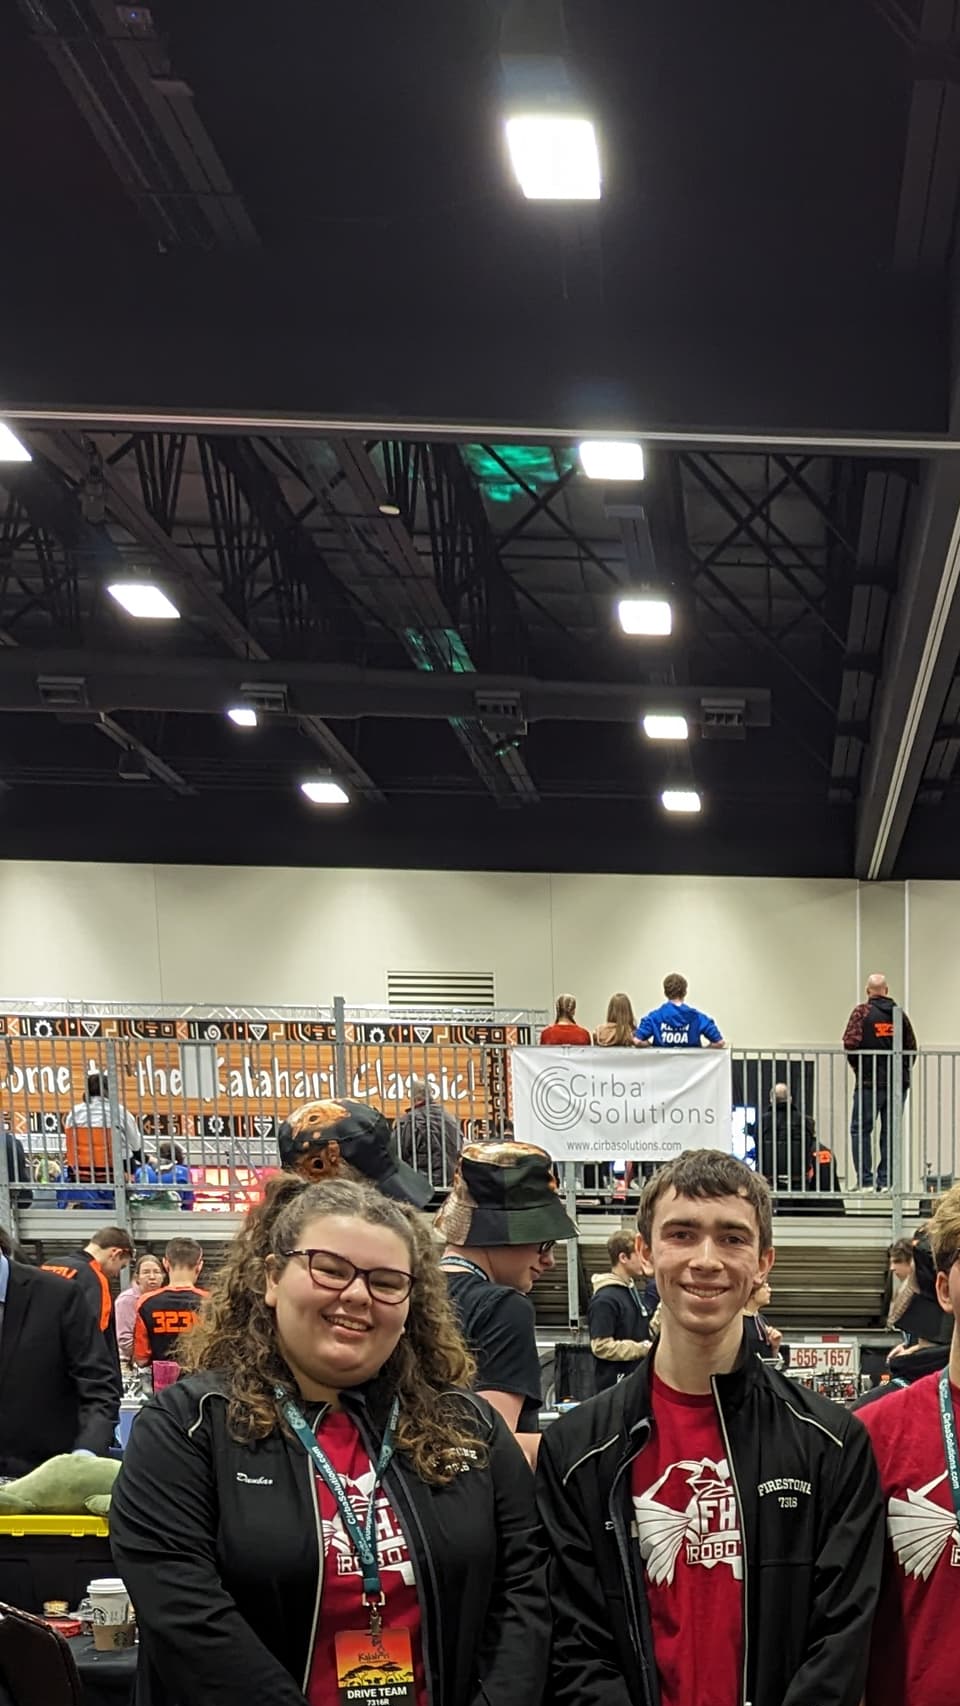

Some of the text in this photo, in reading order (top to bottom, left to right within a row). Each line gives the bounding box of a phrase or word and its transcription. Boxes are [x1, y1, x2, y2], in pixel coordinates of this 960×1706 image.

[661, 1032, 689, 1044] 100A
[135, 1055, 182, 1097] the
[204, 1055, 336, 1101] alahari
[570, 1073, 643, 1098] Cirba
[589, 1100, 715, 1124] Solutions
[567, 1140, 682, 1152] www.cirbasolutions.com
[152, 1311, 200, 1333] 323
[311, 1446, 356, 1525] CirbaSolutions.com
[757, 1478, 811, 1496] FIRESTONE
[347, 1686, 407, 1699] DRIVE TEAM
